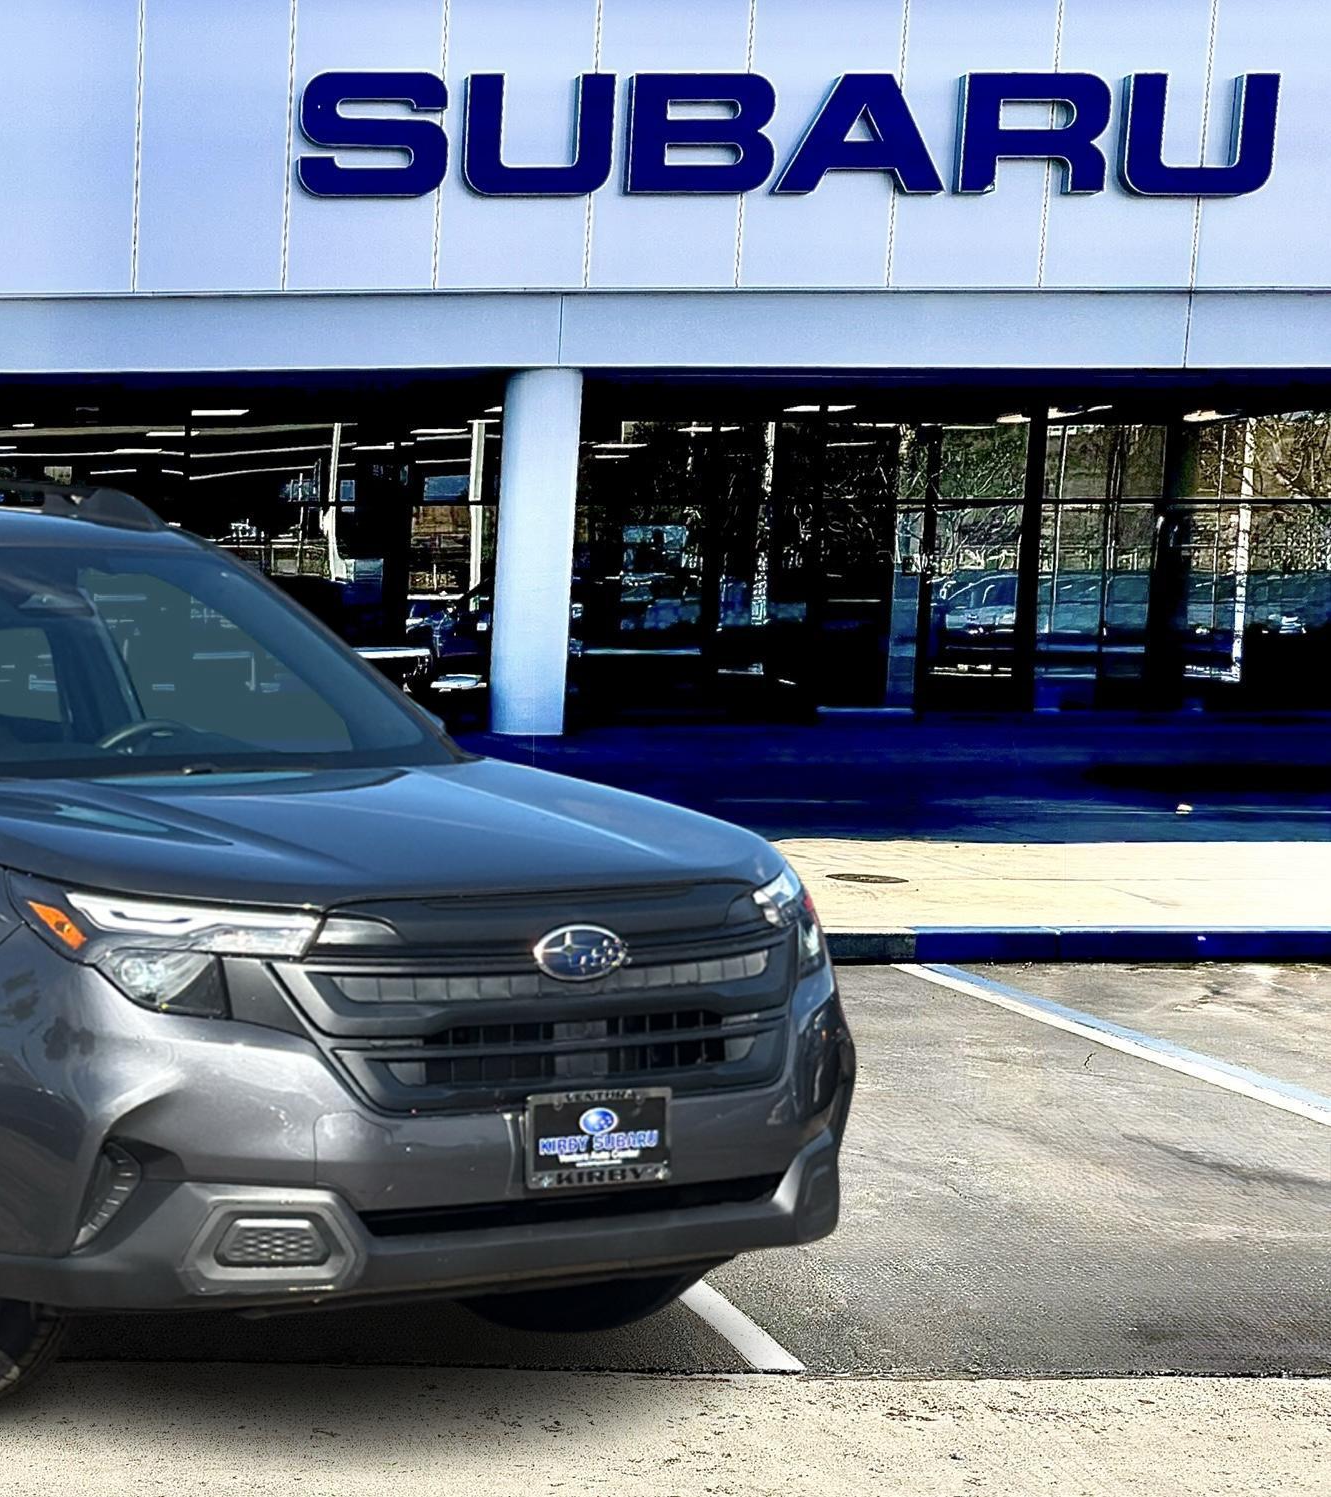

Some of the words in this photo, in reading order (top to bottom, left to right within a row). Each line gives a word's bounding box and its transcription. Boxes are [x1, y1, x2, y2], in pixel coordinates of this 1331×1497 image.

[297, 72, 1282, 197] SUBARU
[565, 1089, 636, 1103] VENTURA
[539, 1136, 589, 1156] KIRBY
[593, 1130, 658, 1150] SUBARU
[556, 1168, 646, 1186] KIRBY
